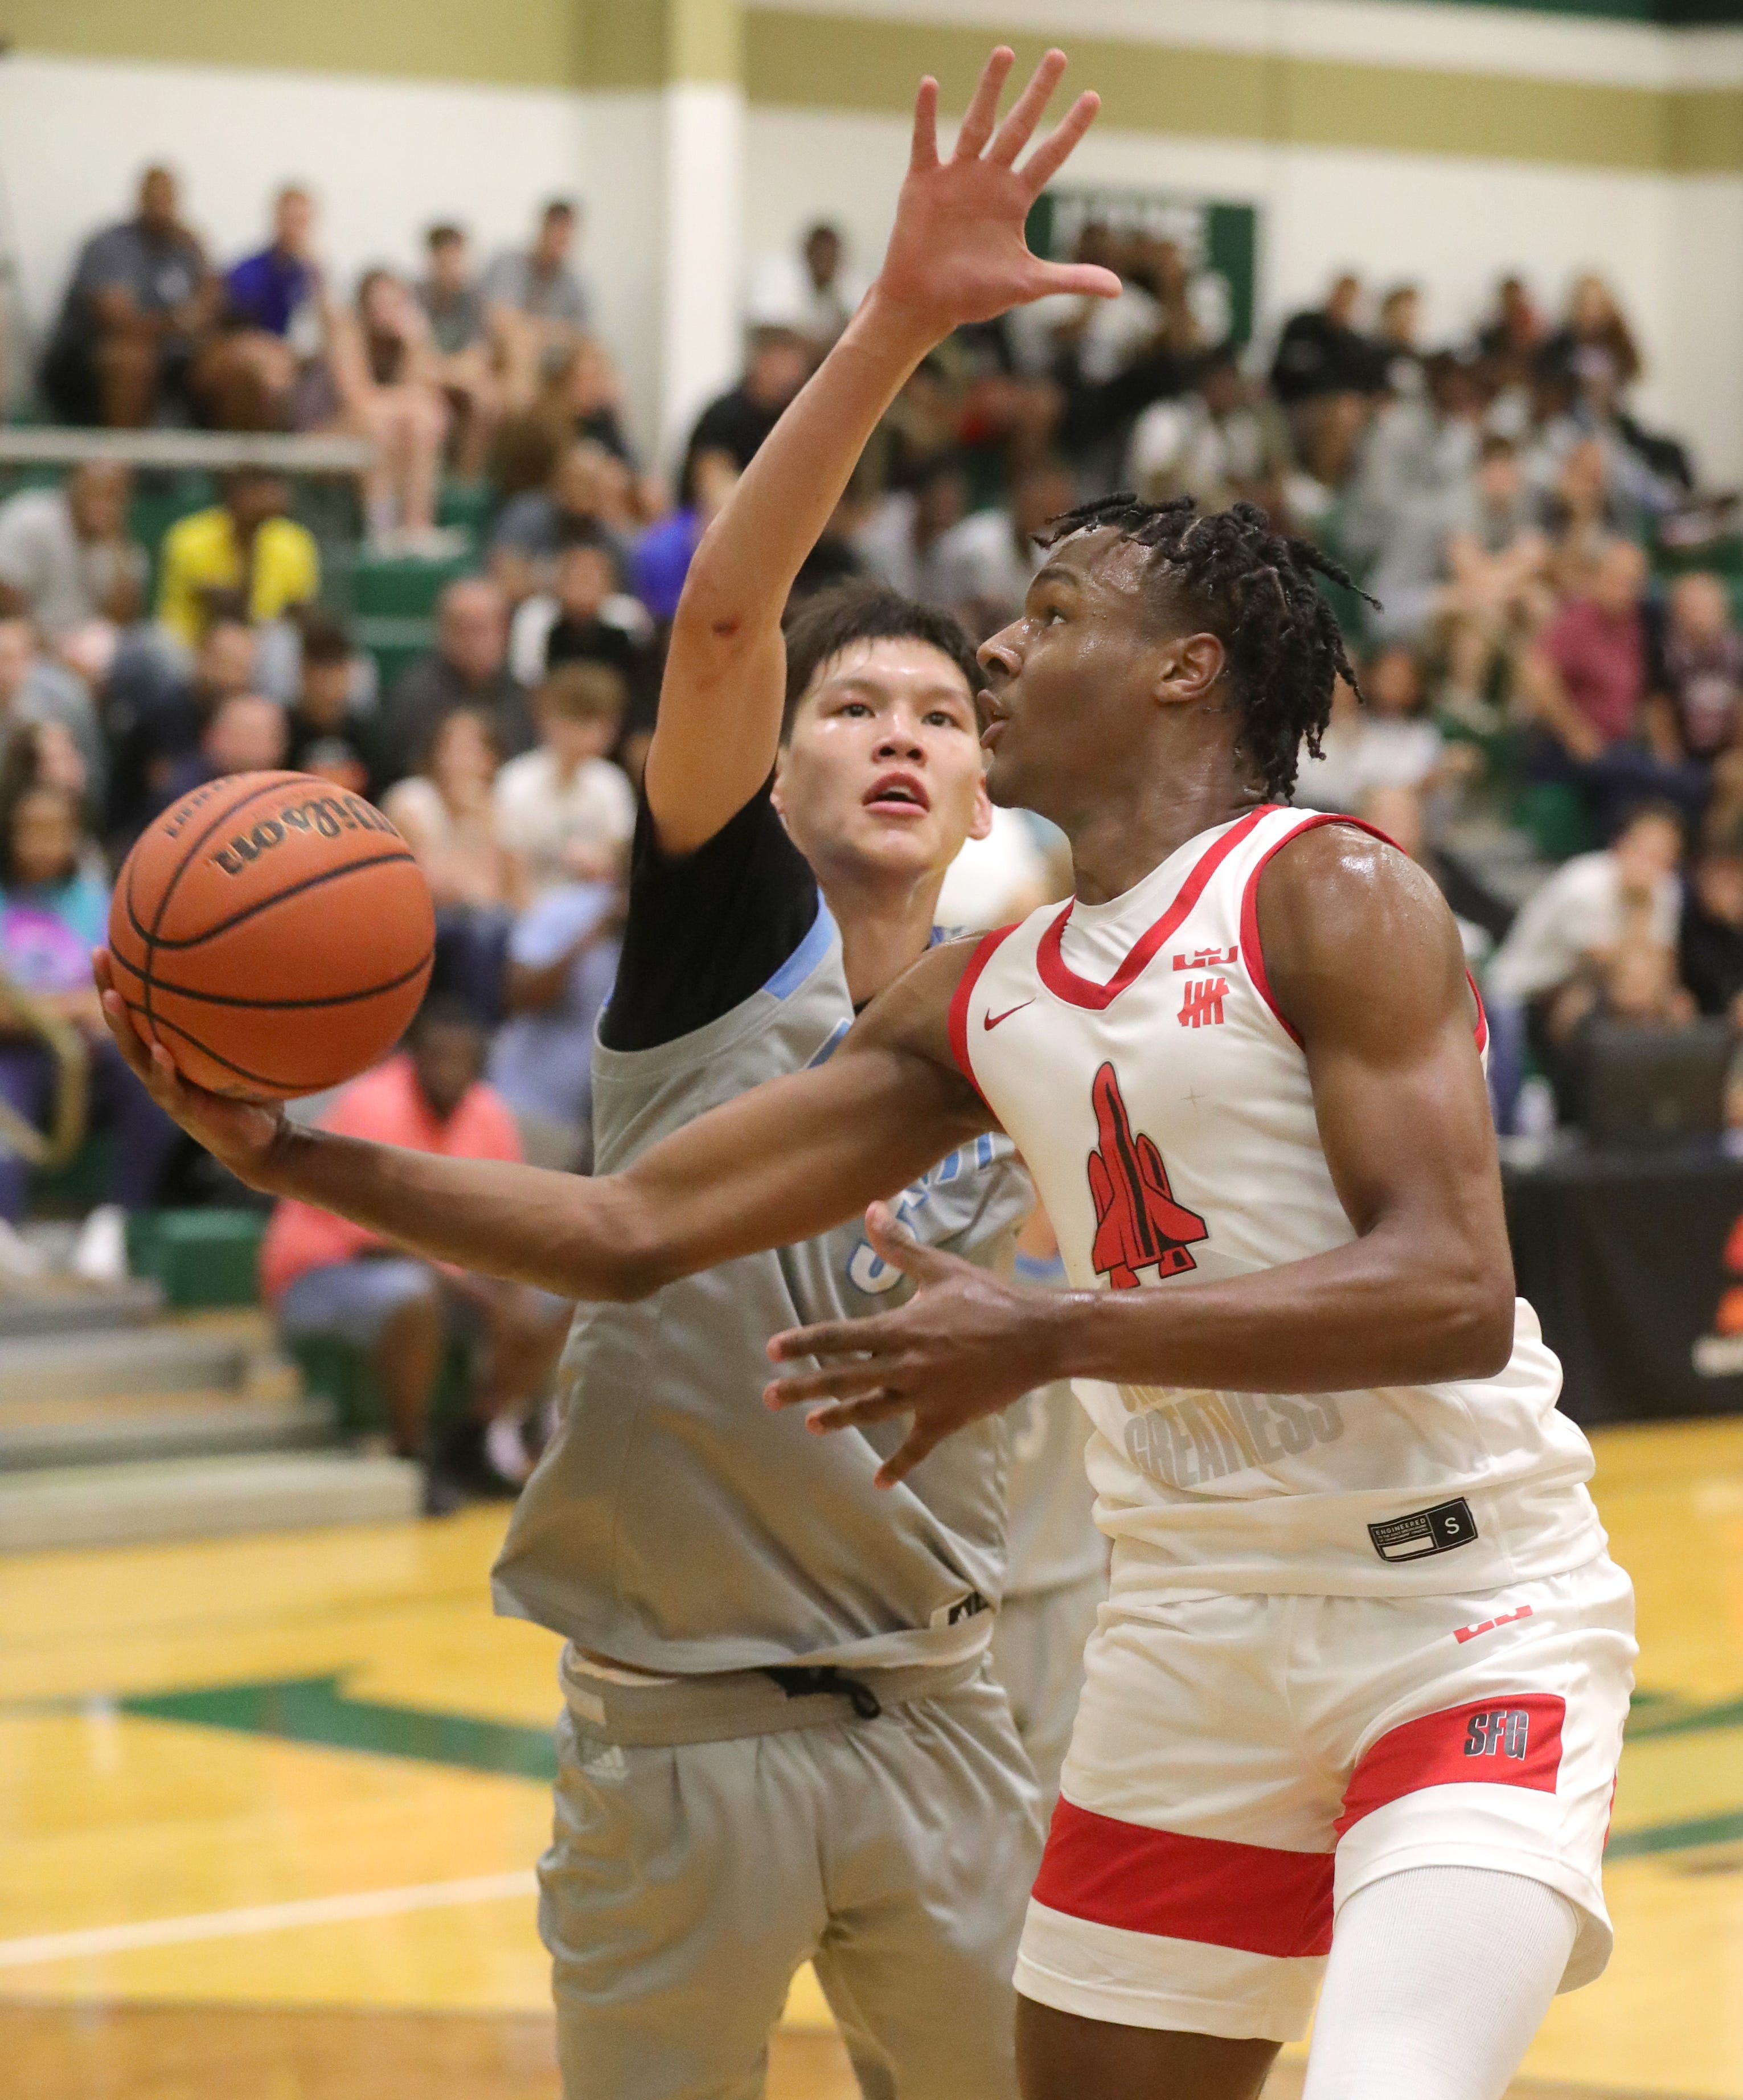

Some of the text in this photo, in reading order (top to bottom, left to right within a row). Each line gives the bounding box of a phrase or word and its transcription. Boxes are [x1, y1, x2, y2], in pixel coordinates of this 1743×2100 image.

[1375, 1518, 1426, 1536] ENGINEERED
[1445, 1517, 1459, 1534] S
[1464, 1709, 1529, 1761] SFG
